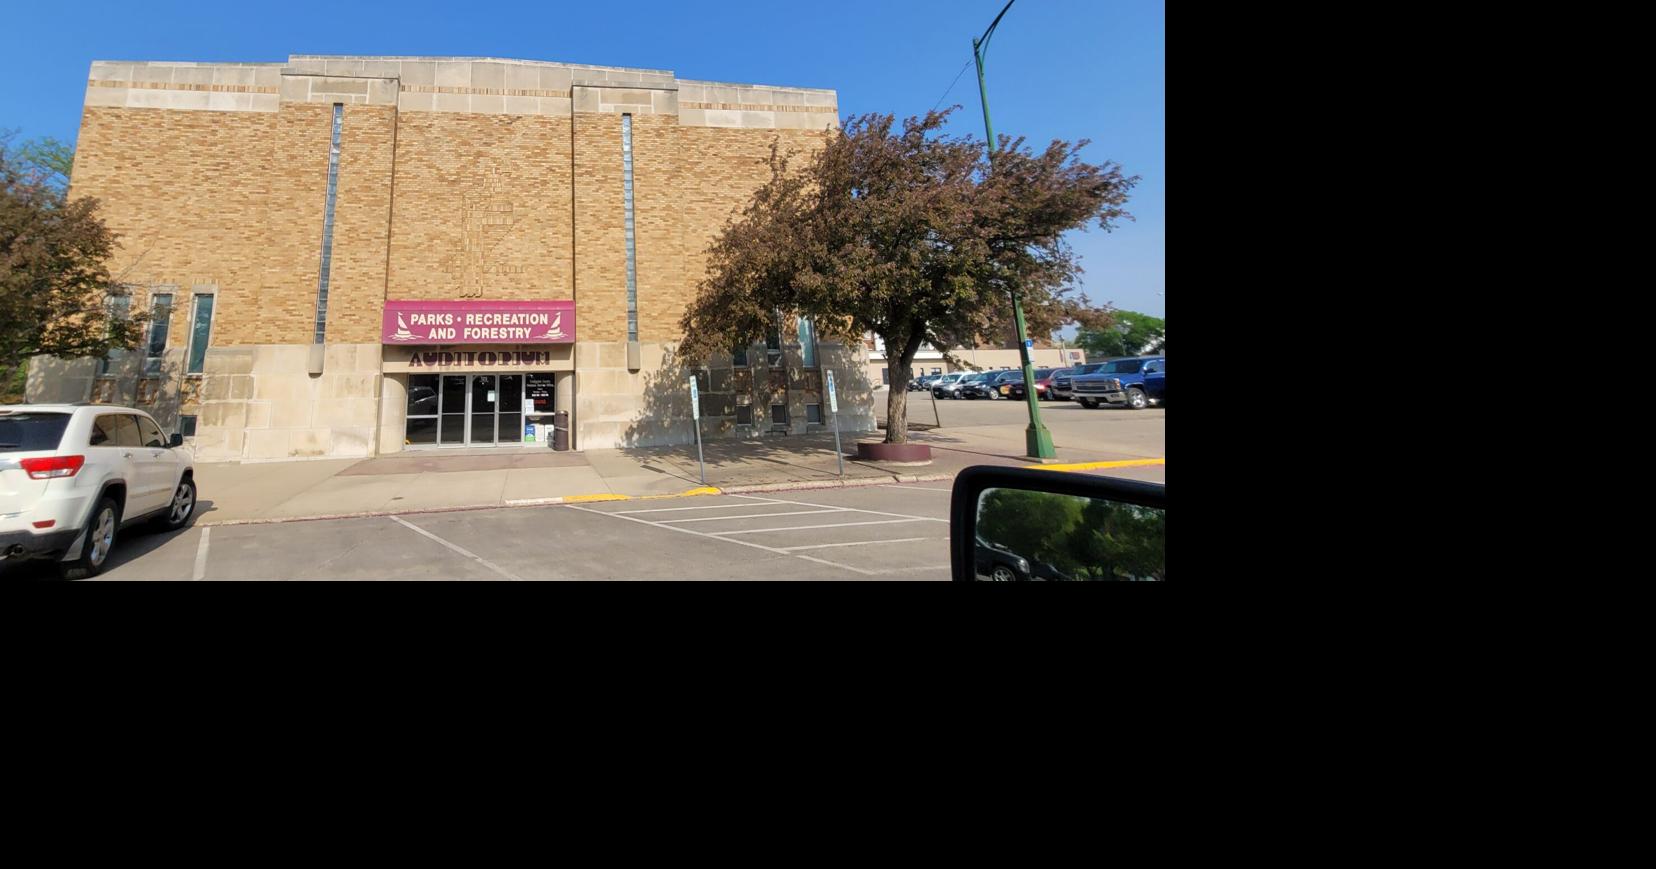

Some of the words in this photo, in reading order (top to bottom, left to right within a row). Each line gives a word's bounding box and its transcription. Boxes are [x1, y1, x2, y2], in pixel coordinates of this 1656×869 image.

[410, 313, 454, 325] PARKS
[466, 313, 548, 325] RECREATION
[428, 327, 456, 339] AND
[463, 327, 532, 339] FORESTRY
[408, 351, 550, 367] AUDITORIUM
